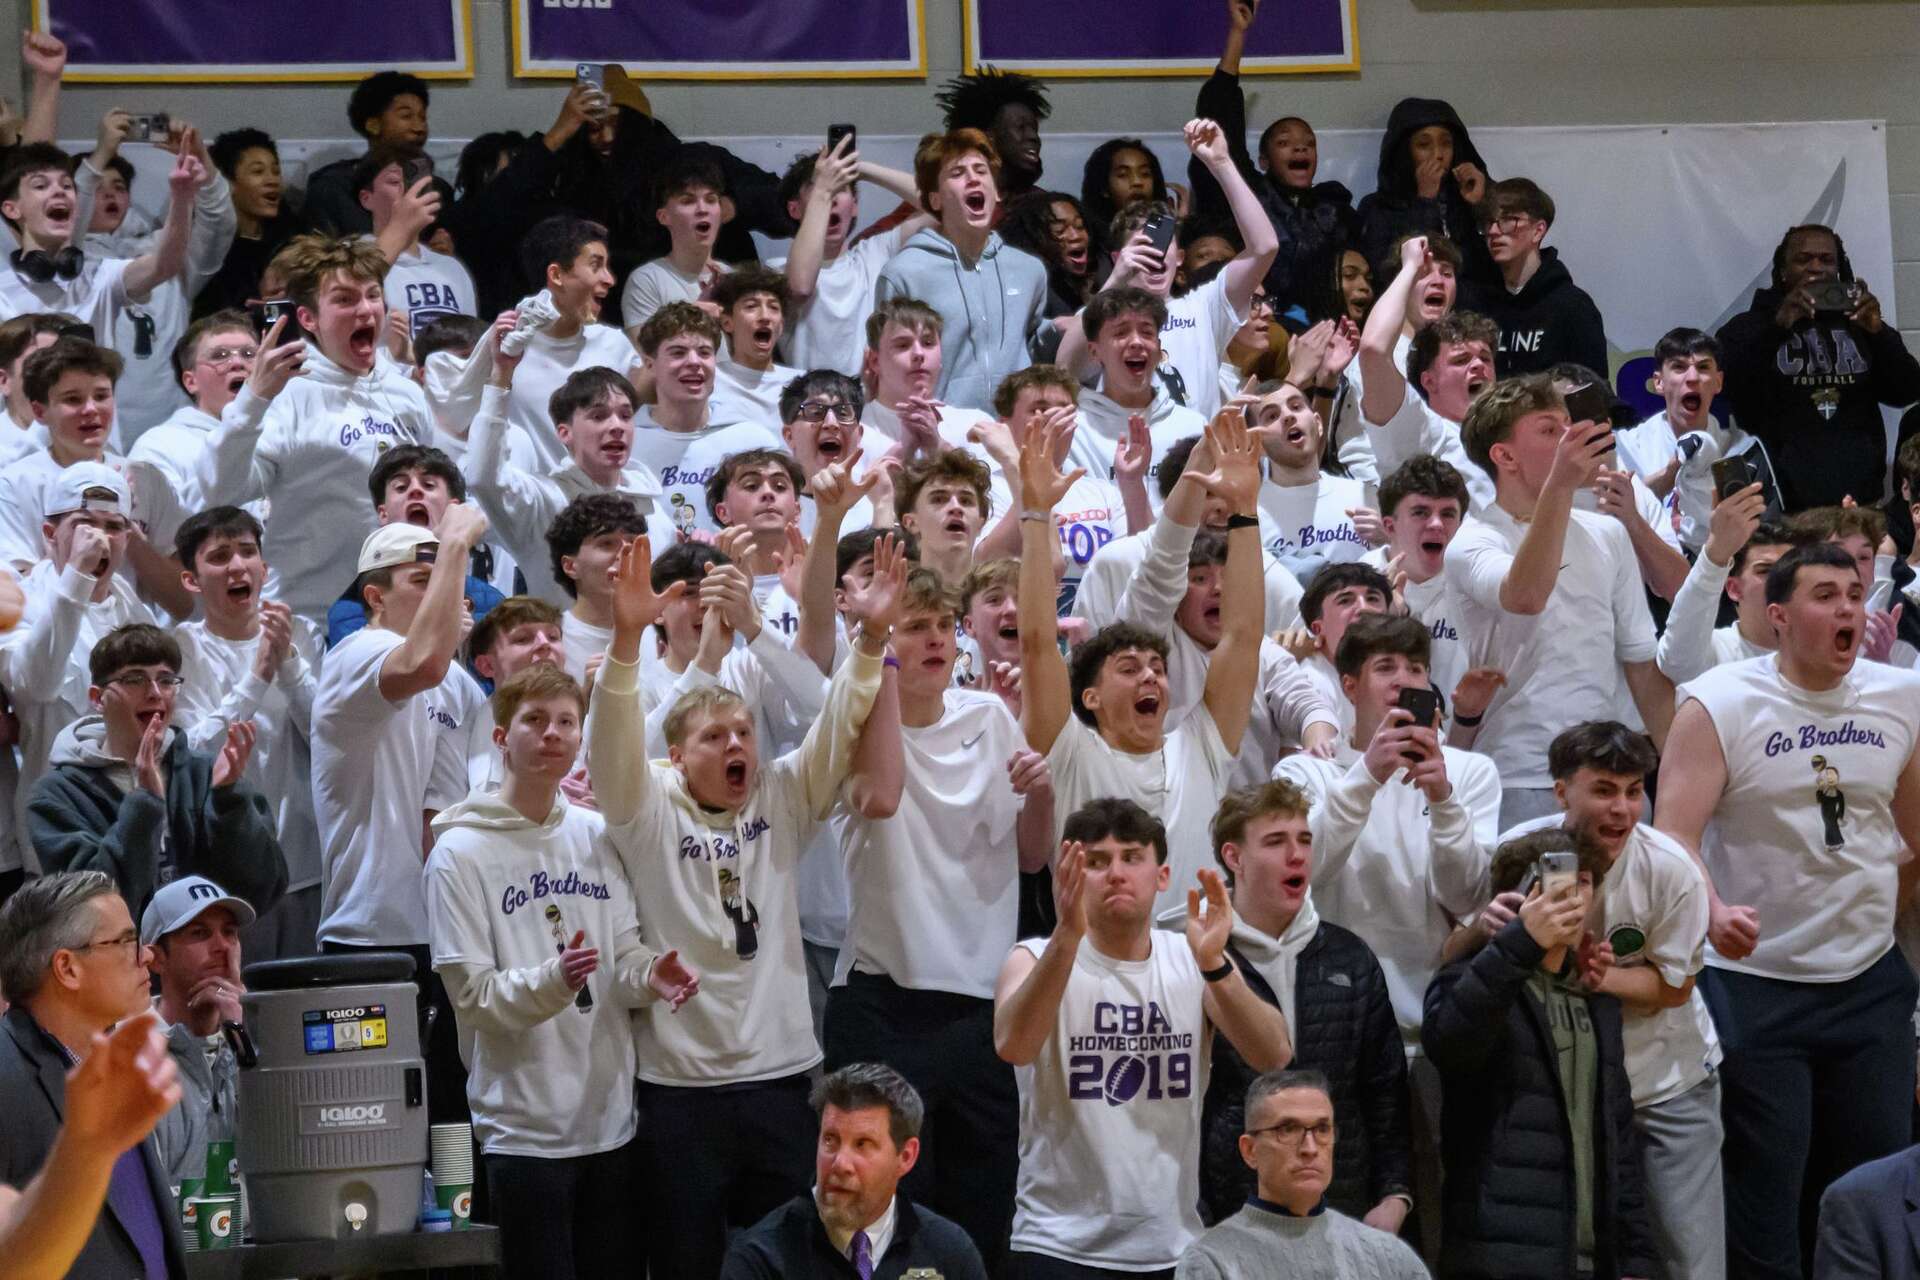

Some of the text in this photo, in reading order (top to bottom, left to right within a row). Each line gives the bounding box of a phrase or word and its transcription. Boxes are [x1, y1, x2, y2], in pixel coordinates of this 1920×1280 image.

[406, 283, 459, 309] CBA
[1777, 328, 1868, 375] CBA
[1793, 375, 1856, 385] FOOTBALL
[340, 423, 361, 447] Go
[1765, 720, 1886, 757] Go Brothers
[681, 836, 702, 861] Go
[501, 885, 528, 915] Go
[326, 1008, 366, 1019] IGLOO
[1094, 1001, 1172, 1035] CBA
[1069, 1033, 1192, 1051] HOMECOMING
[320, 1102, 385, 1122] IGLOO
